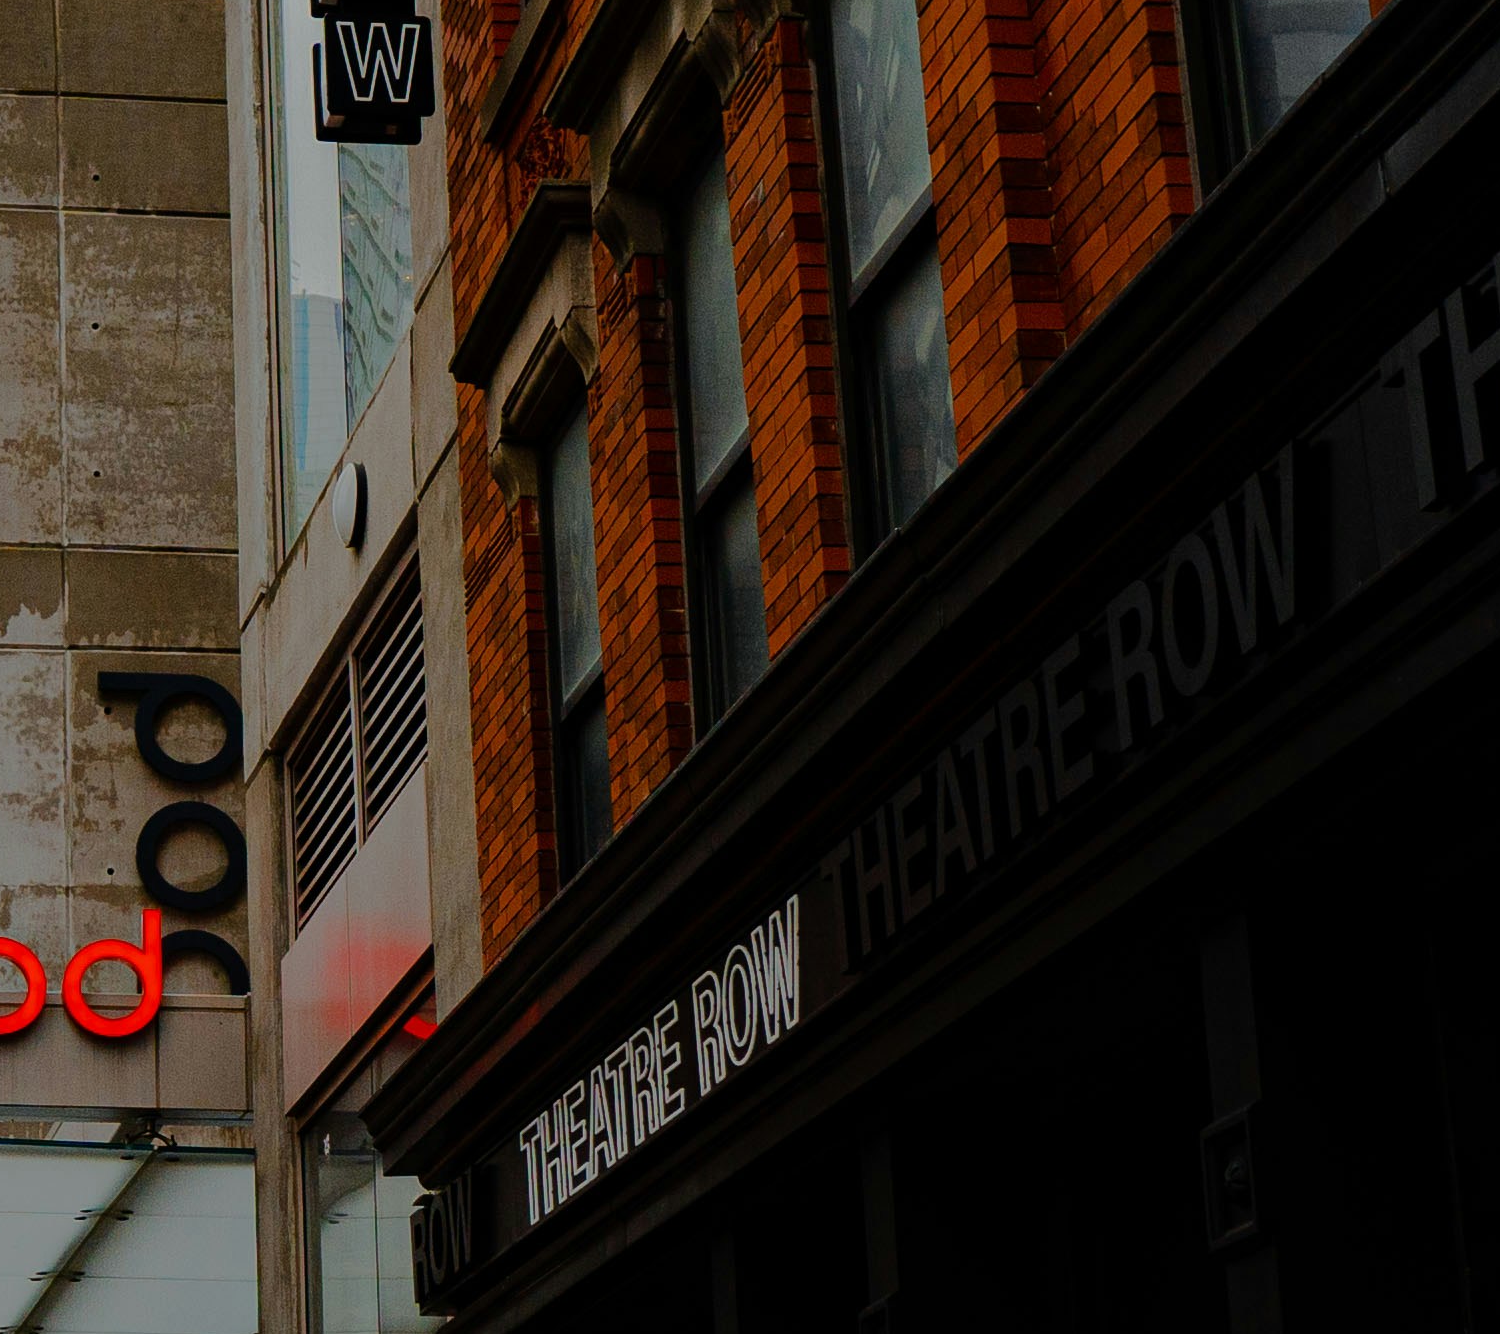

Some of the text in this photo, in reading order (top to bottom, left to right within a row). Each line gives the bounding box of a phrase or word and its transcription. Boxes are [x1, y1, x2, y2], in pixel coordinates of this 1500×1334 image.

[818, 440, 1298, 975] THEATRE ROW
[520, 894, 801, 1224] THEATRE ROW
